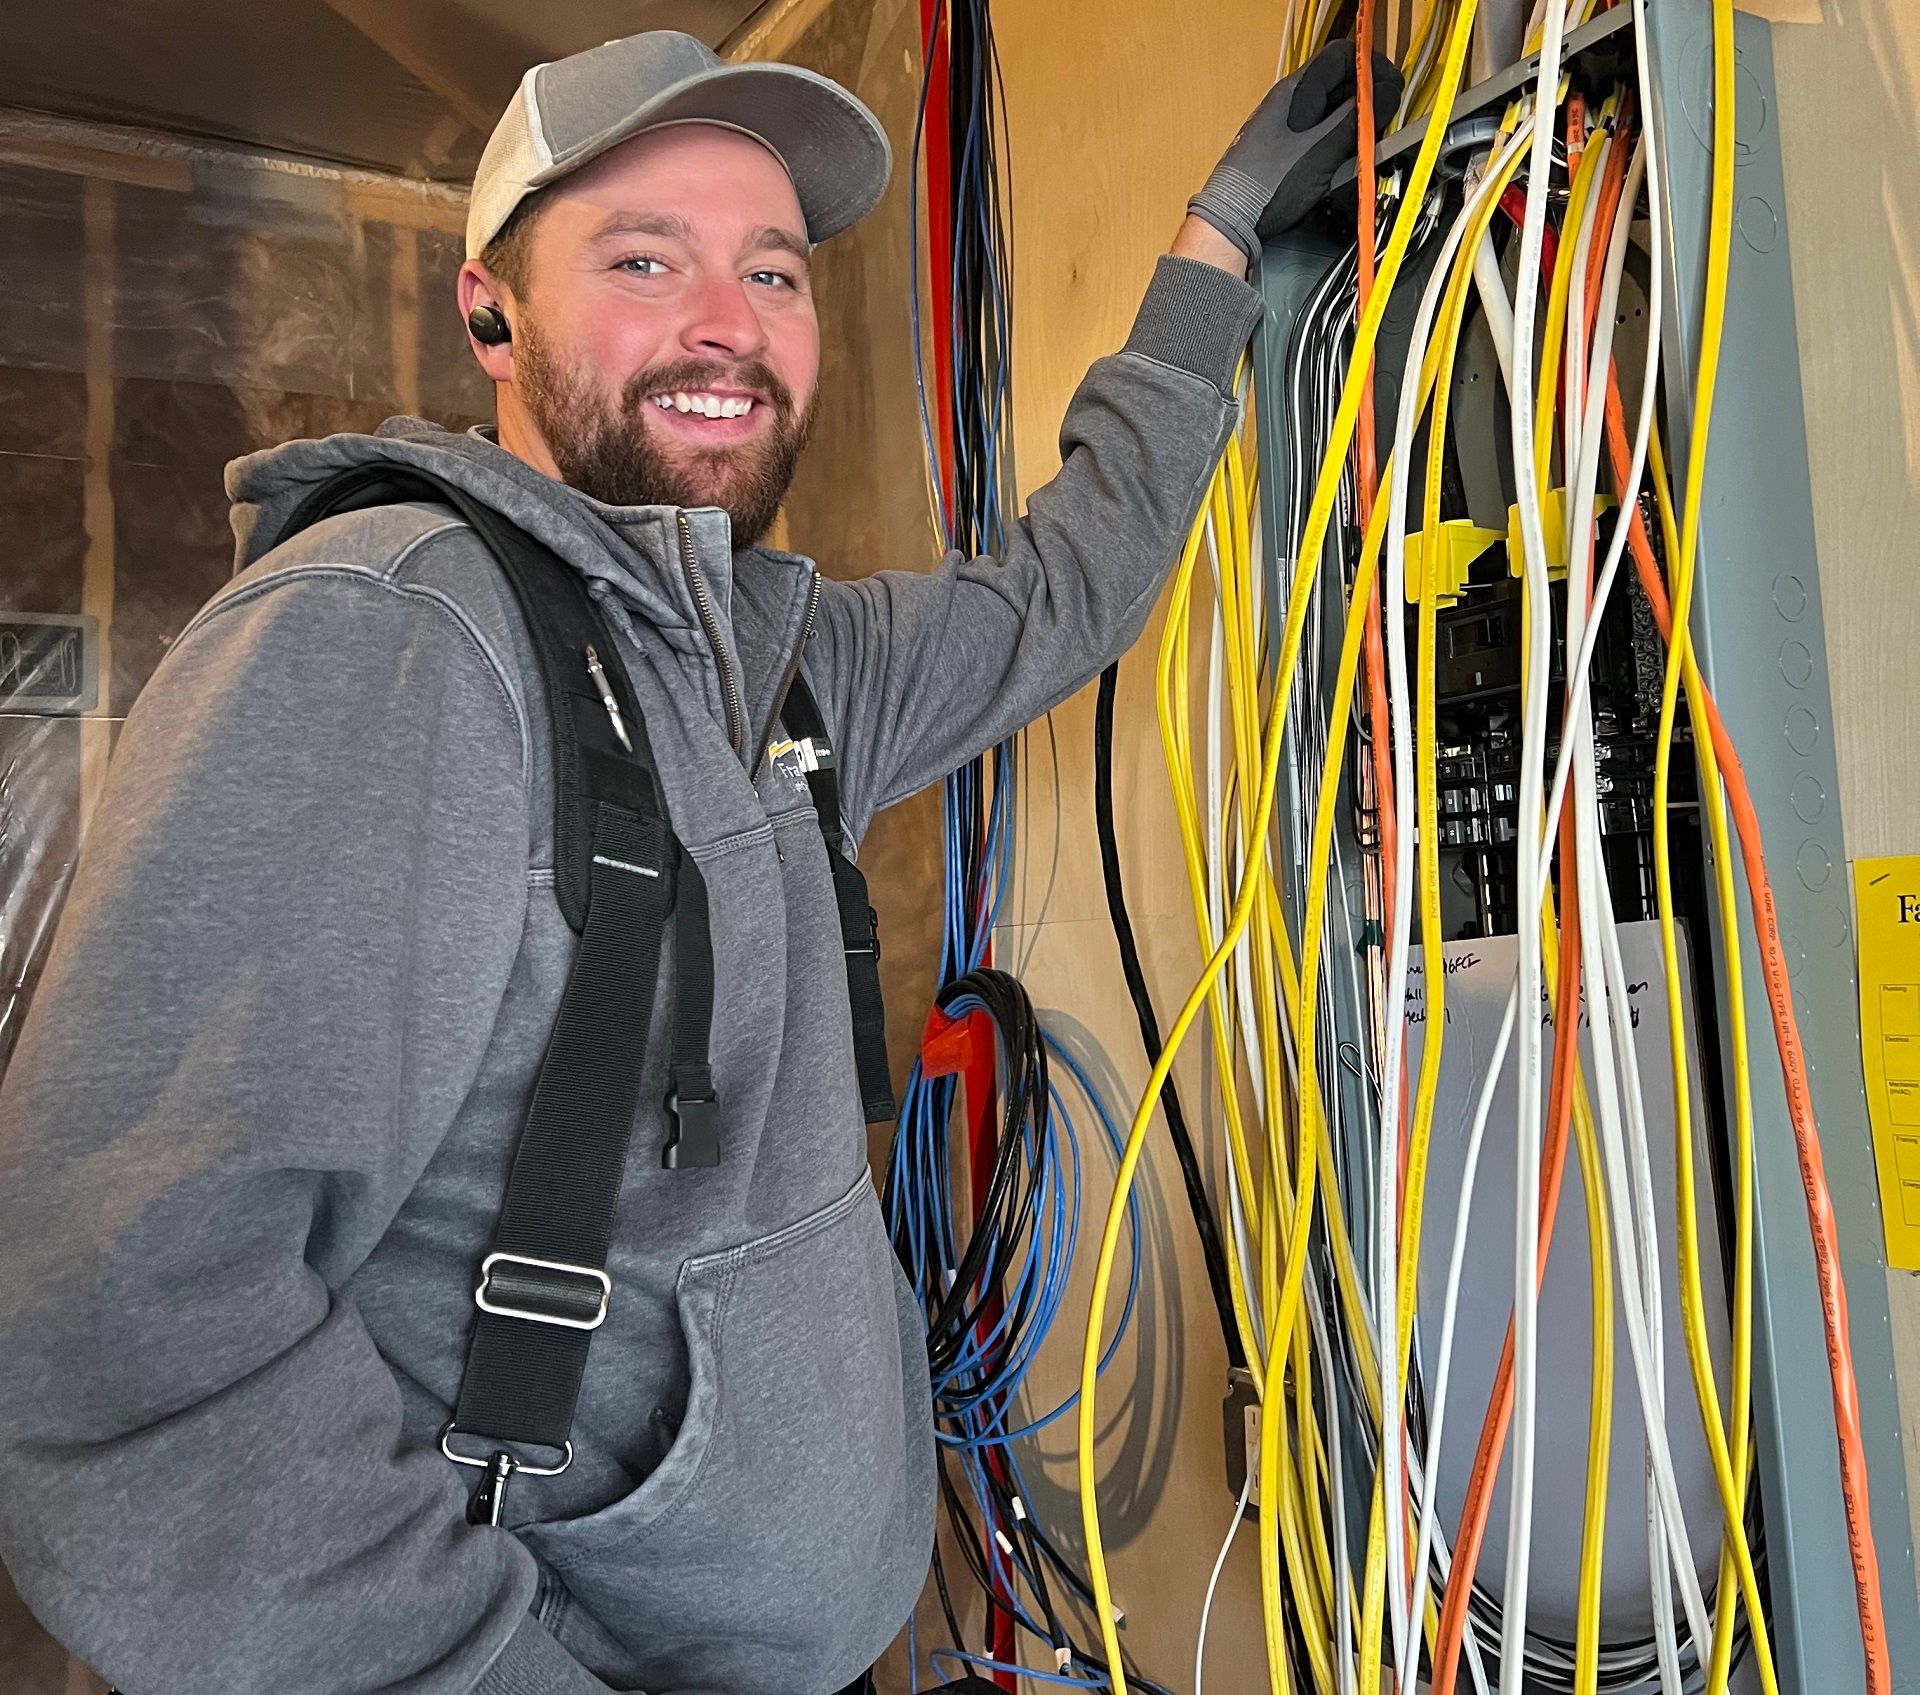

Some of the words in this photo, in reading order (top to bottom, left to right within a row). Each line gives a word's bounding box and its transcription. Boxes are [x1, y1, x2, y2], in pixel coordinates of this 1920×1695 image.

[1763, 890, 1773, 913] WIRE
[1767, 914, 1777, 940] CORP
[1786, 1048, 1799, 1075] 600V
